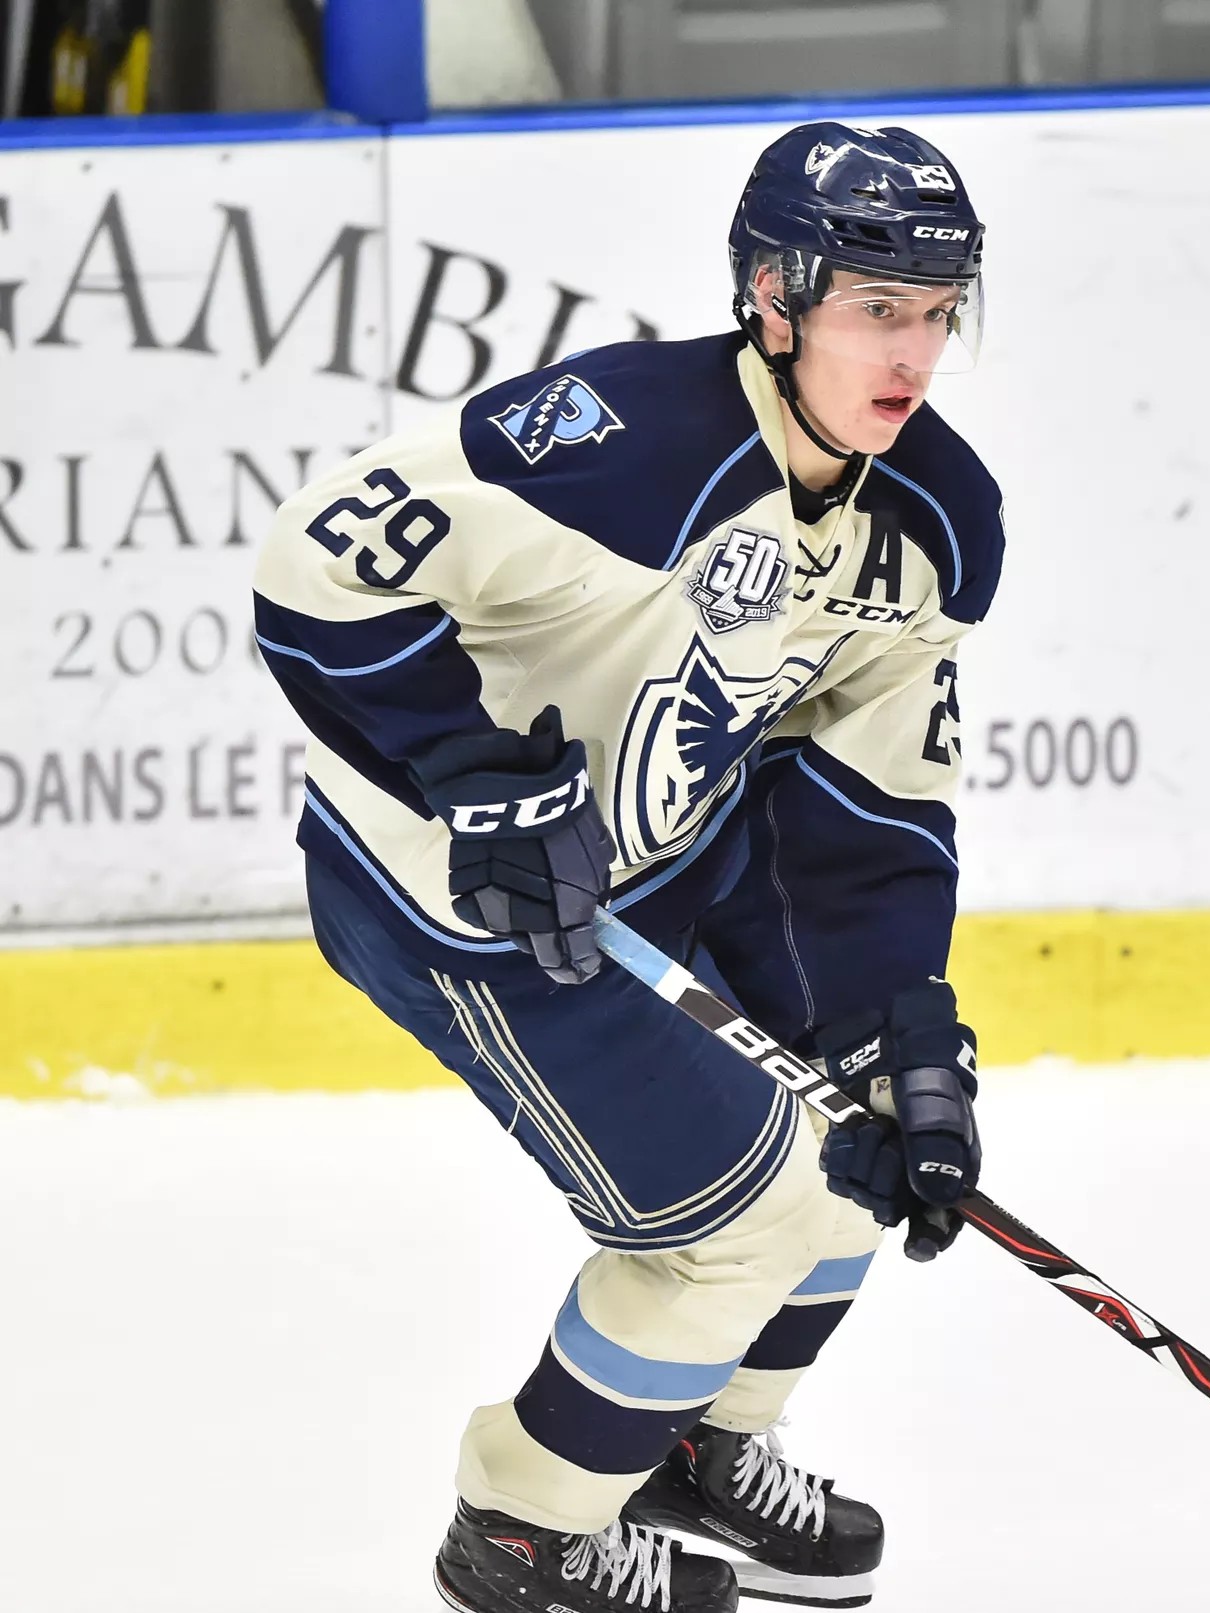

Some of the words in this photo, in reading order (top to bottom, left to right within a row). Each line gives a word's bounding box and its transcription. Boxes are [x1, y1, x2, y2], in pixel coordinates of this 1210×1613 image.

[912, 225, 970, 241] CCM
[0, 187, 661, 400] AMBI
[524, 378, 570, 454] PHOENIX
[305, 467, 452, 590] 29
[709, 528, 781, 603] 50
[853, 508, 902, 603] A
[50, 607, 266, 681] 200
[744, 607, 768, 617] 2019
[823, 597, 917, 624] CCM
[921, 658, 962, 766] 2
